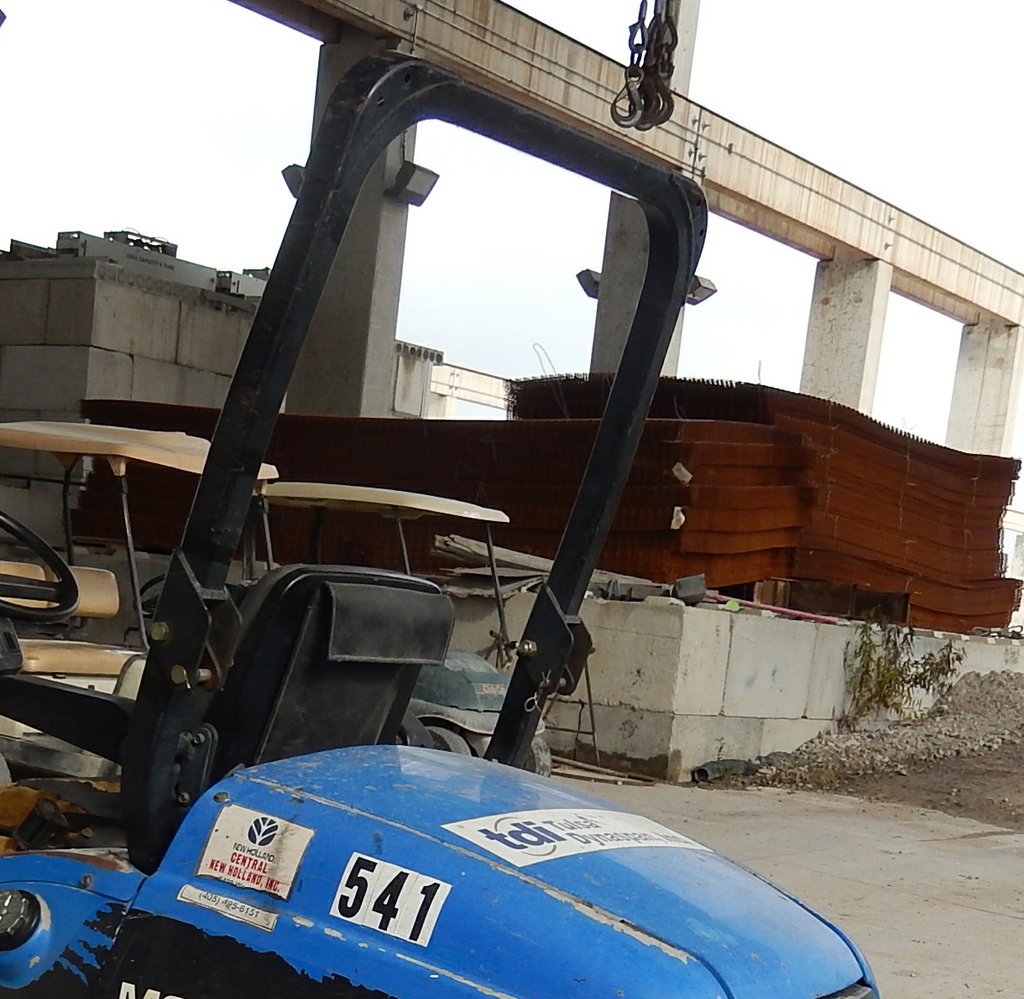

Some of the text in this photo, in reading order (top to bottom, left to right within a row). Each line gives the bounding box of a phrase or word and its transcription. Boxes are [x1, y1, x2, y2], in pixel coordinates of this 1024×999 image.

[477, 820, 567, 849] tdi
[209, 858, 227, 873] NEW
[230, 852, 268, 874] CENTRAL
[338, 856, 441, 942] 541
